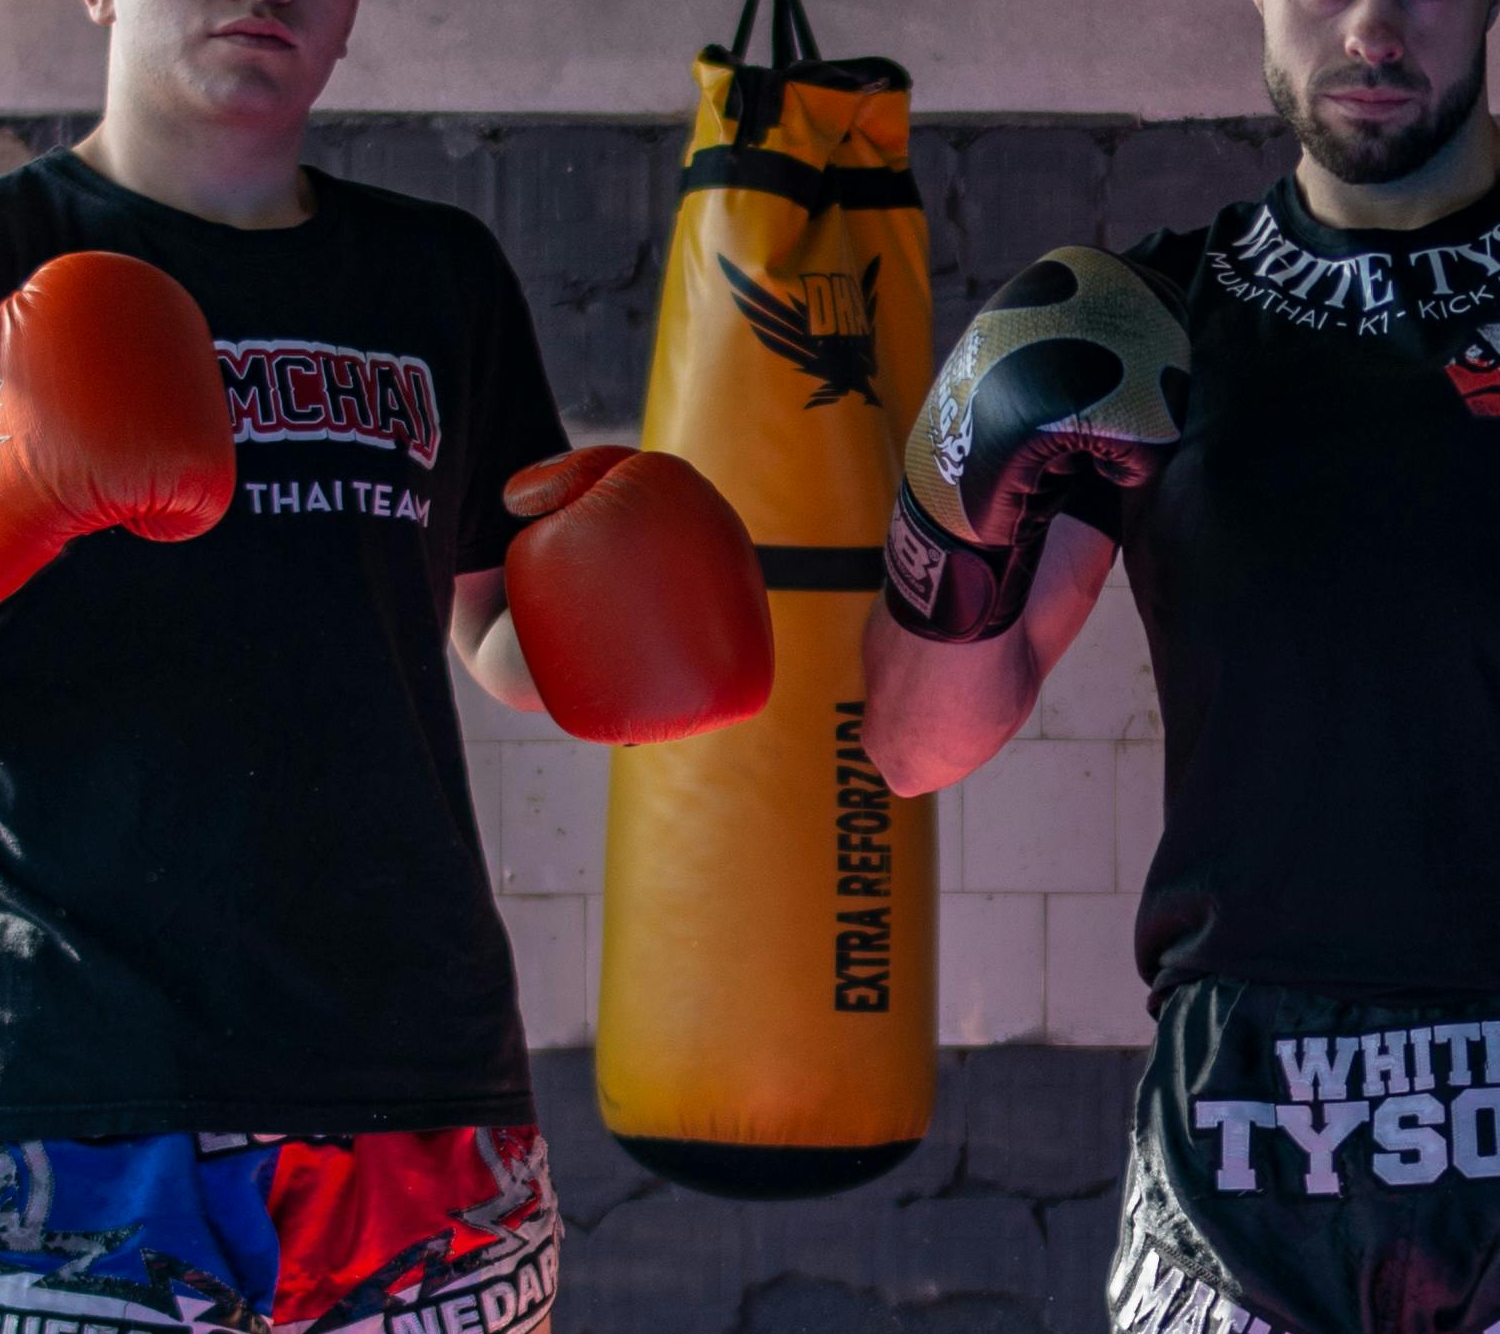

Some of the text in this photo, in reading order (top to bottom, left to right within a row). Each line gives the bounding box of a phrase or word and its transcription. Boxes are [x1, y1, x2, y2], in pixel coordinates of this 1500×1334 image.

[1206, 251, 1328, 332] MUAYTHAI
[1358, 311, 1390, 337] K1
[1418, 285, 1495, 322] KICK
[1232, 204, 1394, 311] WHITE
[245, 480, 432, 528] THAI TEAM
[835, 905, 892, 1013] EXTRA
